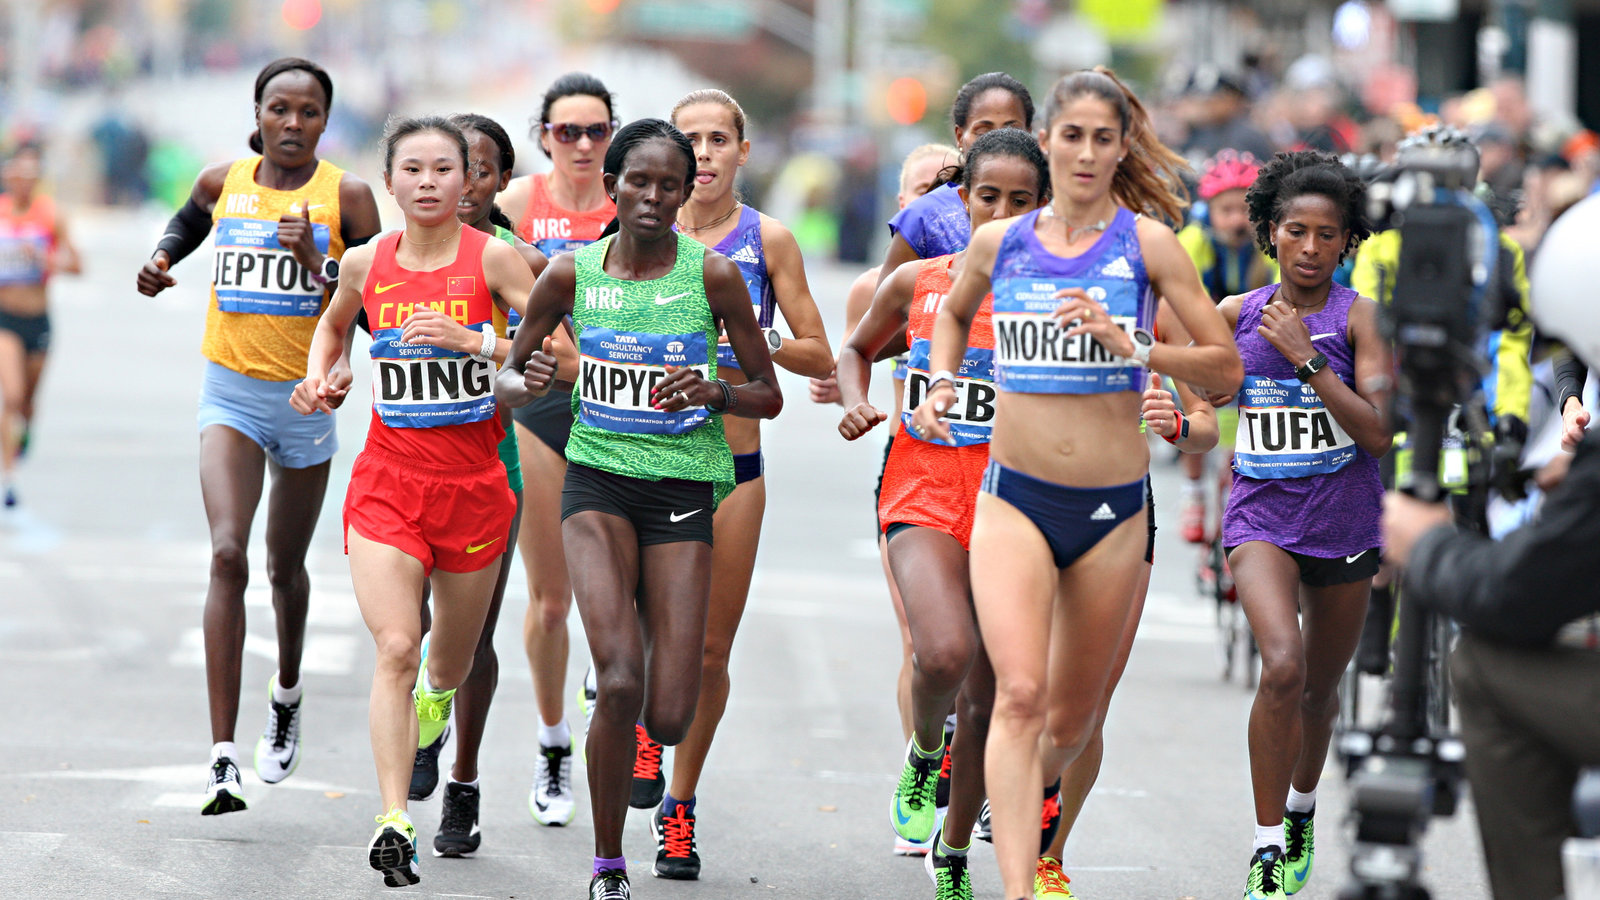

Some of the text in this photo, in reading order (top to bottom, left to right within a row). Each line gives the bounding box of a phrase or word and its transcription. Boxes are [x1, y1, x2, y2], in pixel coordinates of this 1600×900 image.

[225, 193, 259, 214] NRC
[532, 218, 572, 238] NRC
[732, 254, 760, 263] adidas
[585, 286, 624, 310] NRC
[378, 300, 468, 328] CHNA
[614, 335, 638, 344] TATA
[998, 321, 1125, 363] MOREI
[399, 347, 433, 356] SERVICES
[600, 340, 653, 354] CONSULTANCY
[608, 350, 643, 361] SERVICES
[663, 354, 687, 362] TATA
[380, 360, 491, 401] DING
[583, 361, 704, 408] KIPYE
[1245, 388, 1289, 397] CONSULTANCY
[1251, 396, 1285, 404] SERVICES
[589, 409, 600, 417] TCS
[1245, 411, 1338, 451] TUFA
